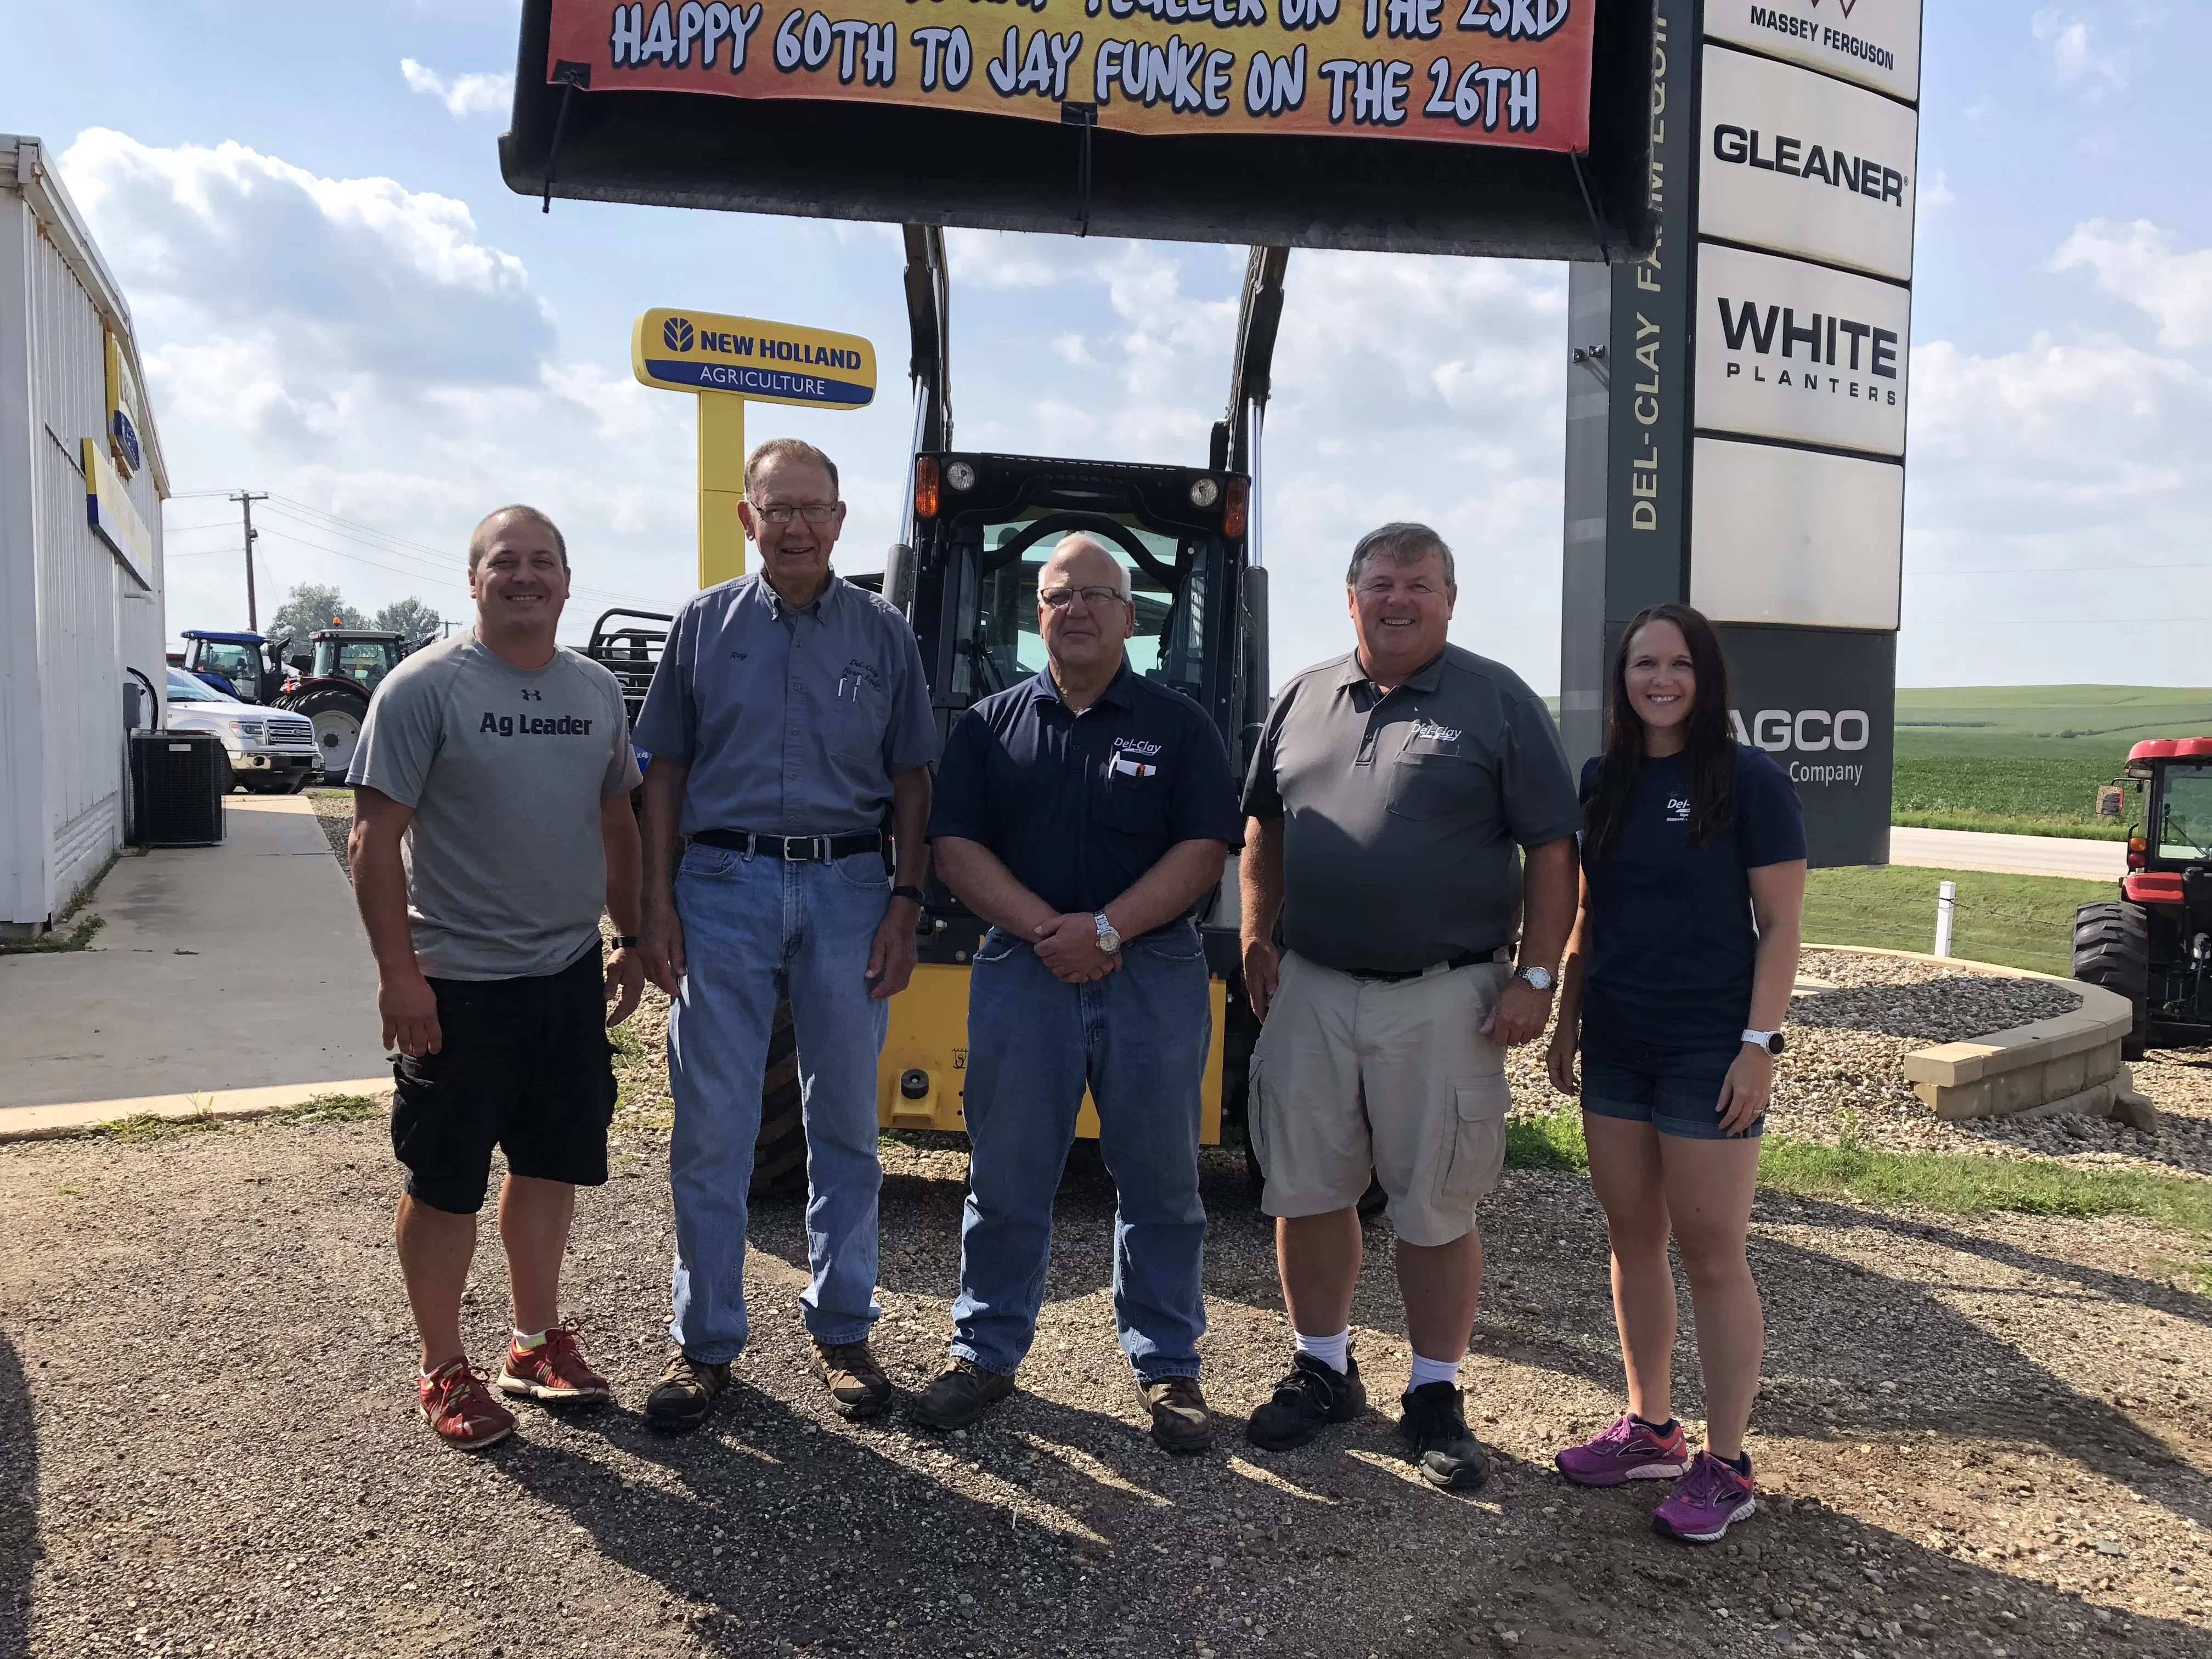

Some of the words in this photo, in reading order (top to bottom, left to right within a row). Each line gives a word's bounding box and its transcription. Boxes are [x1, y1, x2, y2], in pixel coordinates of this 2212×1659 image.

[1751, 5, 1819, 42] MASSEY
[1824, 26, 1894, 71] FERGUSON
[610, 1, 761, 70] HAPPY
[775, 9, 895, 83] 60TH
[912, 26, 971, 88] TO
[988, 26, 1081, 97] JAY
[1096, 35, 1234, 110] FUNKE
[1246, 44, 1306, 112] ON
[1320, 60, 1412, 122] THE
[1424, 57, 1538, 127] 26TH
[701, 330, 754, 356] NEW
[760, 339, 861, 370] HOLLAND
[1717, 297, 1898, 380] WHITE
[699, 365, 826, 396] AGRICULTURE
[1726, 362, 1897, 406] PLANTERS
[1632, 311, 1660, 531] DEL-CLAY
[479, 712, 514, 737] Ag
[519, 713, 593, 736] Leader
[1410, 724, 1462, 741] Del-Clay
[1114, 737, 1161, 755] Del-Clay
[1790, 761, 1863, 787] Company
